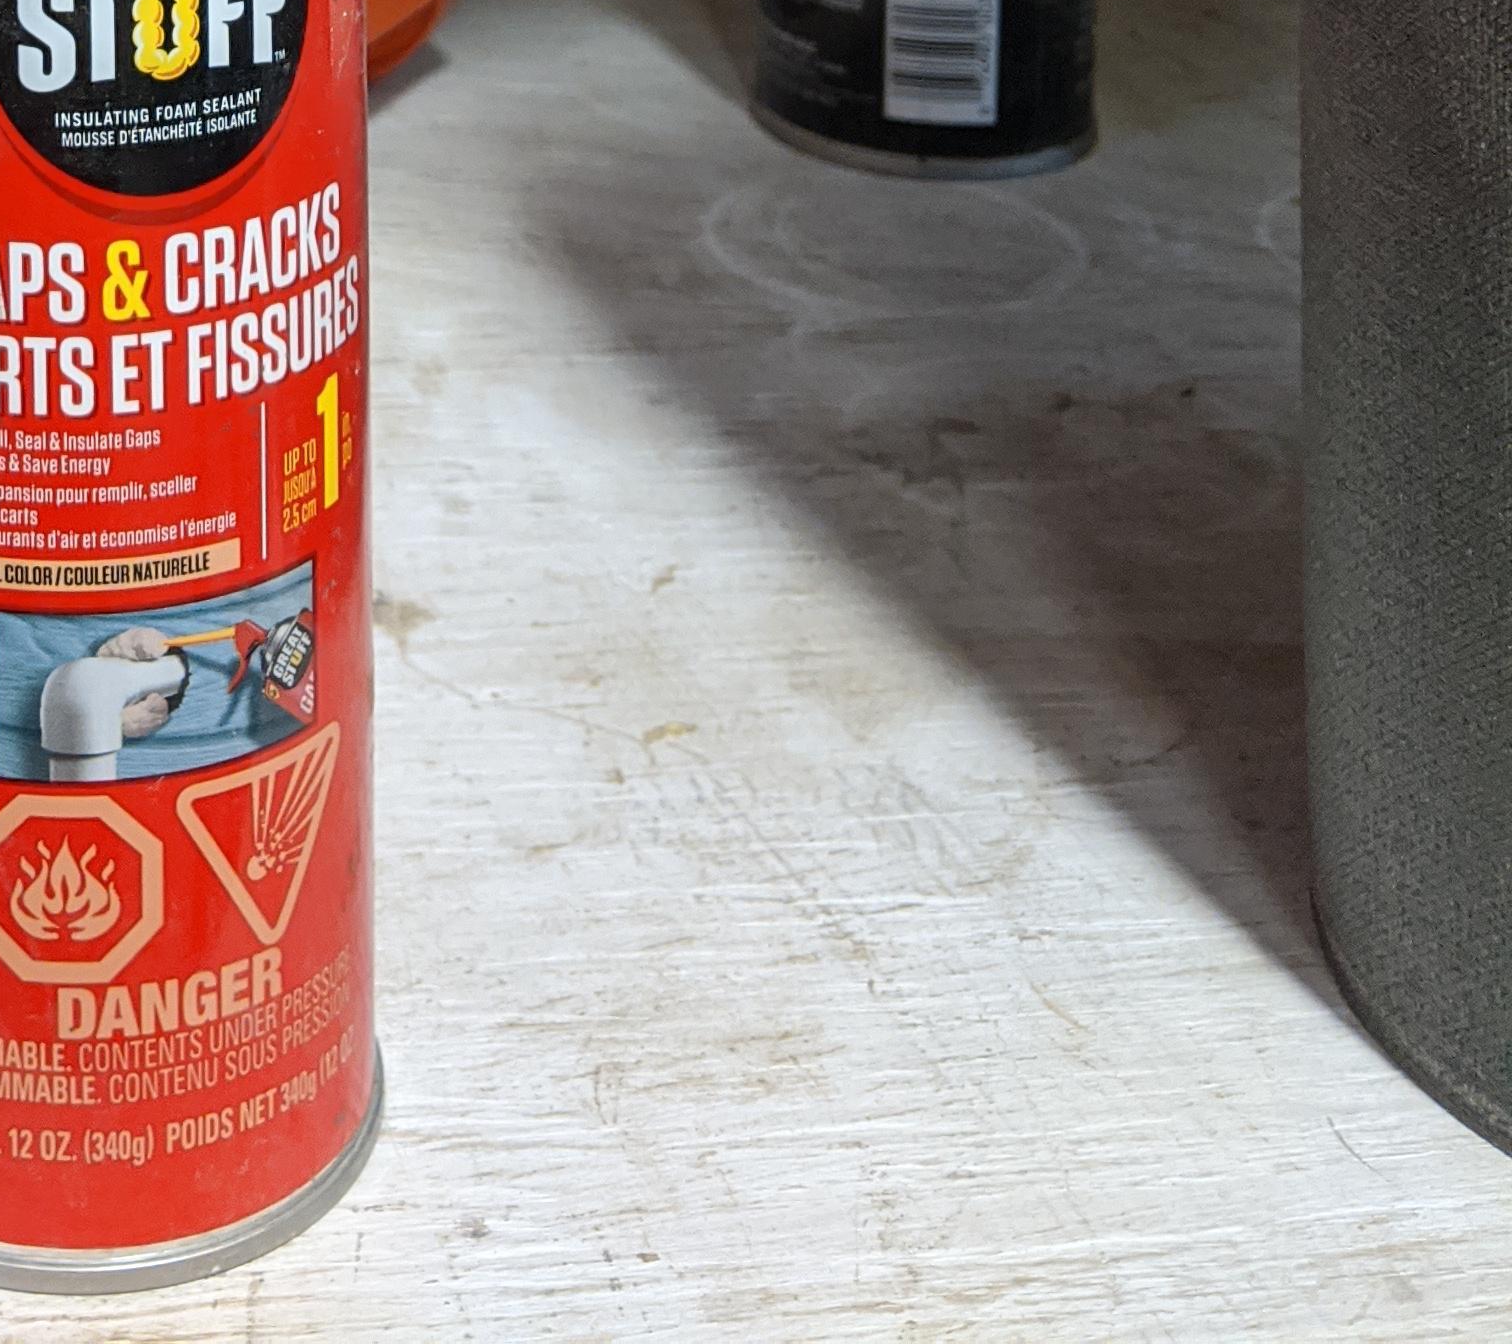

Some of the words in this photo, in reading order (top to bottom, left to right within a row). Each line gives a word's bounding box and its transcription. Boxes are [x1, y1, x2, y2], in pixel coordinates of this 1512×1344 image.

[54, 107, 150, 128] INSULATING
[155, 101, 197, 122] FOAM
[202, 87, 262, 115] SEALANT
[61, 129, 115, 148] MOUSSE
[206, 108, 257, 135] ISOLANTE
[102, 239, 150, 322] &
[164, 181, 341, 316] CRACKS
[111, 329, 173, 413] ET
[188, 256, 359, 404] FISSURES
[15, 430, 47, 451] Seal
[49, 431, 61, 451] &
[63, 430, 123, 452] Insulate
[125, 428, 161, 450] Gaps
[283, 446, 301, 477] UP
[301, 437, 317, 465] TO
[316, 371, 339, 510] 1
[9, 453, 20, 473] &
[22, 453, 58, 474] Save
[60, 455, 111, 477] Energy
[55, 487, 89, 507] pour
[149, 474, 198, 499] sceller
[47, 529, 80, 549] d'air
[82, 530, 97, 549] et
[99, 523, 177, 548] économise
[180, 510, 237, 540] l'énergie
[282, 502, 300, 534] 2.5
[301, 497, 318, 528] cm
[4, 563, 53, 586] COLOR
[63, 564, 130, 587] COULEUR
[132, 550, 211, 583] NATURELLE
[272, 625, 303, 679] GREAT
[56, 947, 283, 1040] DANGER
[78, 1028, 204, 1073] CONTENTS
[209, 1002, 278, 1054] UNDER
[109, 1058, 219, 1104] CONTENU
[224, 1033, 278, 1082] SOUS
[8, 1127, 34, 1160] 12
[39, 1129, 78, 1162] OZ.
[83, 1123, 154, 1167] (340g)
[165, 1107, 234, 1155] POIDS
[239, 1087, 278, 1133] NET
[279, 1069, 317, 1113] 340g
